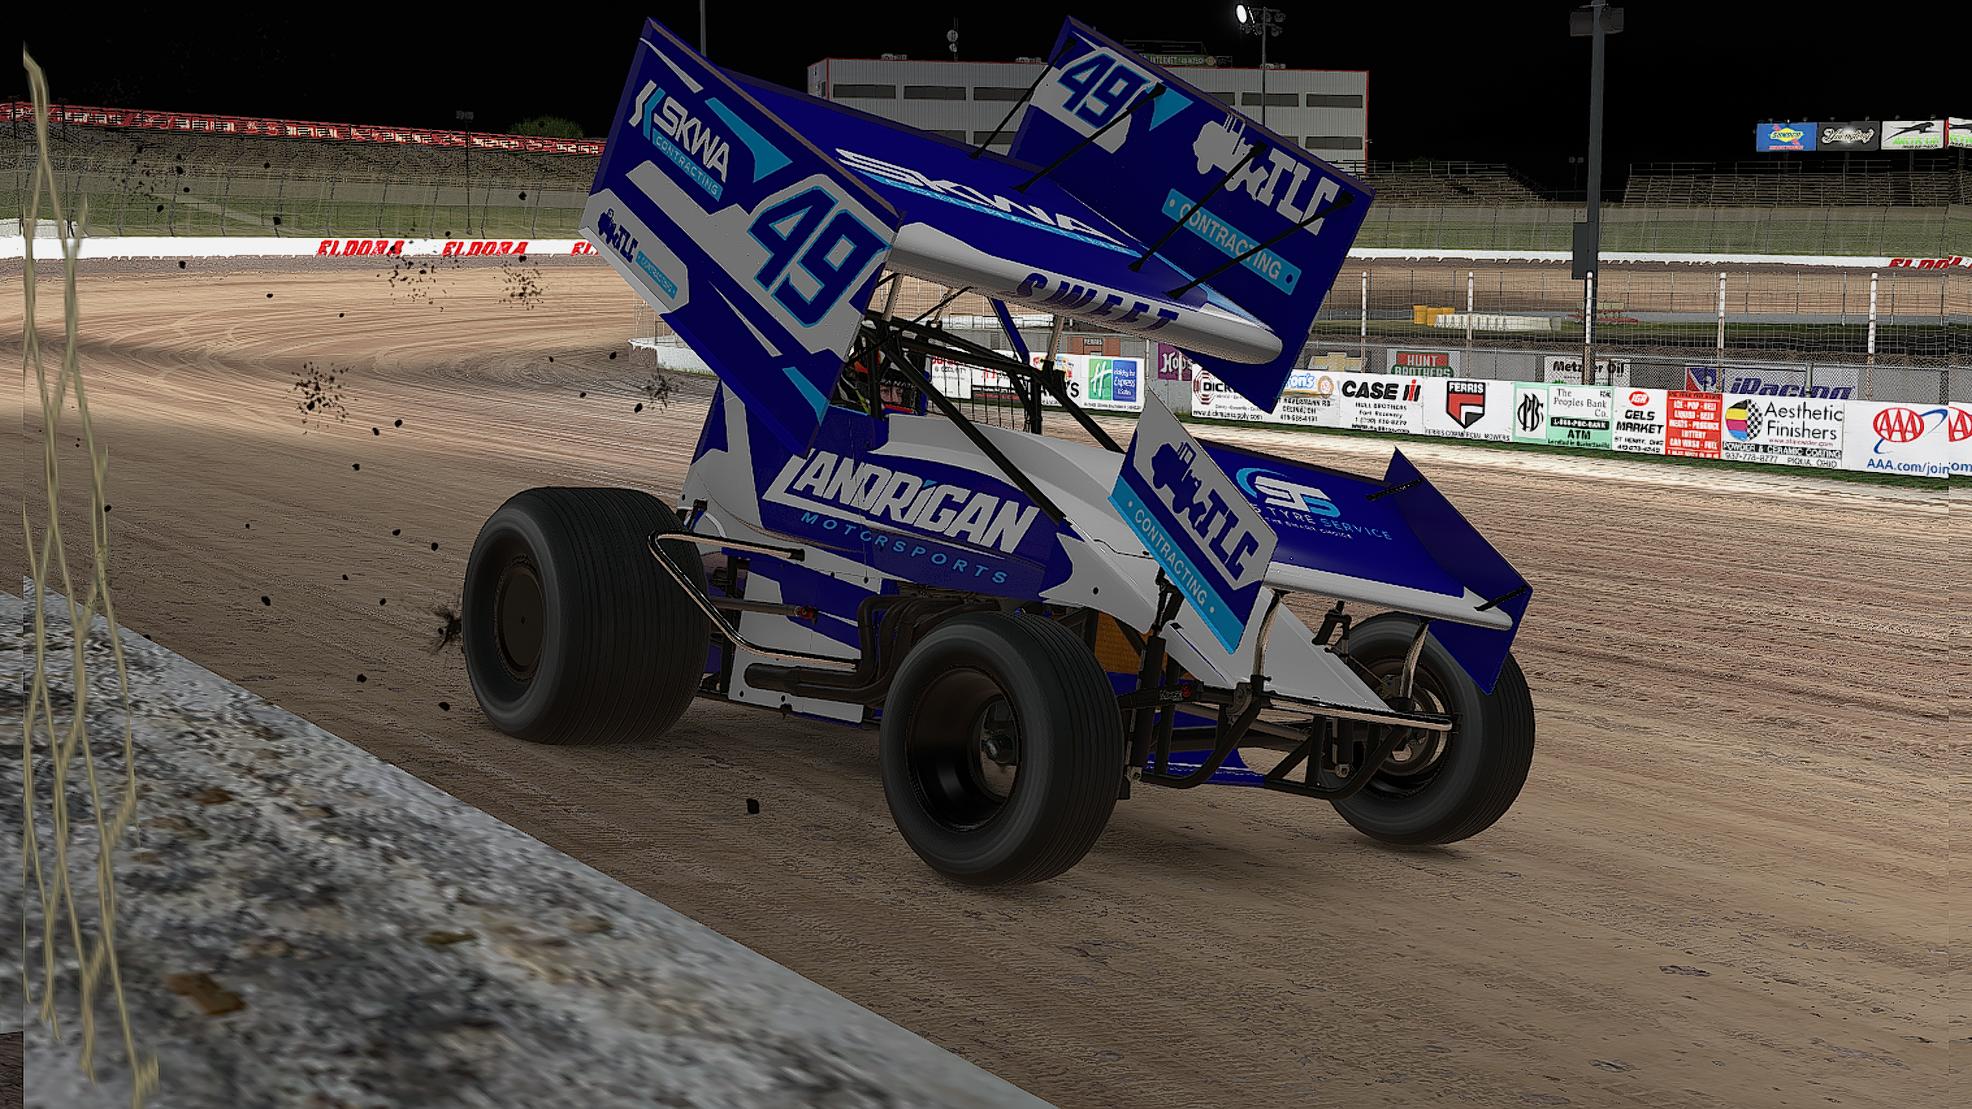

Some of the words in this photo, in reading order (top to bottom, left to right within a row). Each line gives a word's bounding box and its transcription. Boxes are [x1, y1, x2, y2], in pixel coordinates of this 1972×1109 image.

[1057, 52, 1154, 130] 49
[653, 96, 730, 183] SKWA
[655, 135, 719, 196] CONTRACTING
[442, 240, 529, 257] ELDORA
[747, 185, 892, 328] 49
[1407, 354, 1438, 367] HUNT
[1341, 380, 1399, 400] CASE
[1448, 381, 1484, 393] FERRIS
[1557, 388, 1572, 397] The
[1553, 398, 1584, 408] Peoples
[1586, 399, 1607, 408] Bank
[1764, 401, 1843, 422] Aesthetic
[1625, 409, 1656, 421] GELS
[1879, 408, 1921, 442] AAA
[1567, 429, 1591, 440] ATM
[1616, 421, 1664, 435] MARKET
[1767, 420, 1837, 441] Finishers
[762, 448, 1041, 555] LANDRIGAN
[1266, 506, 1317, 525] TYRE
[1319, 517, 1393, 541] SERVICE
[1195, 488, 1260, 581] TLC
[800, 511, 1008, 585] MOTORSPORTS
[1134, 508, 1208, 606] CONTRACTING
